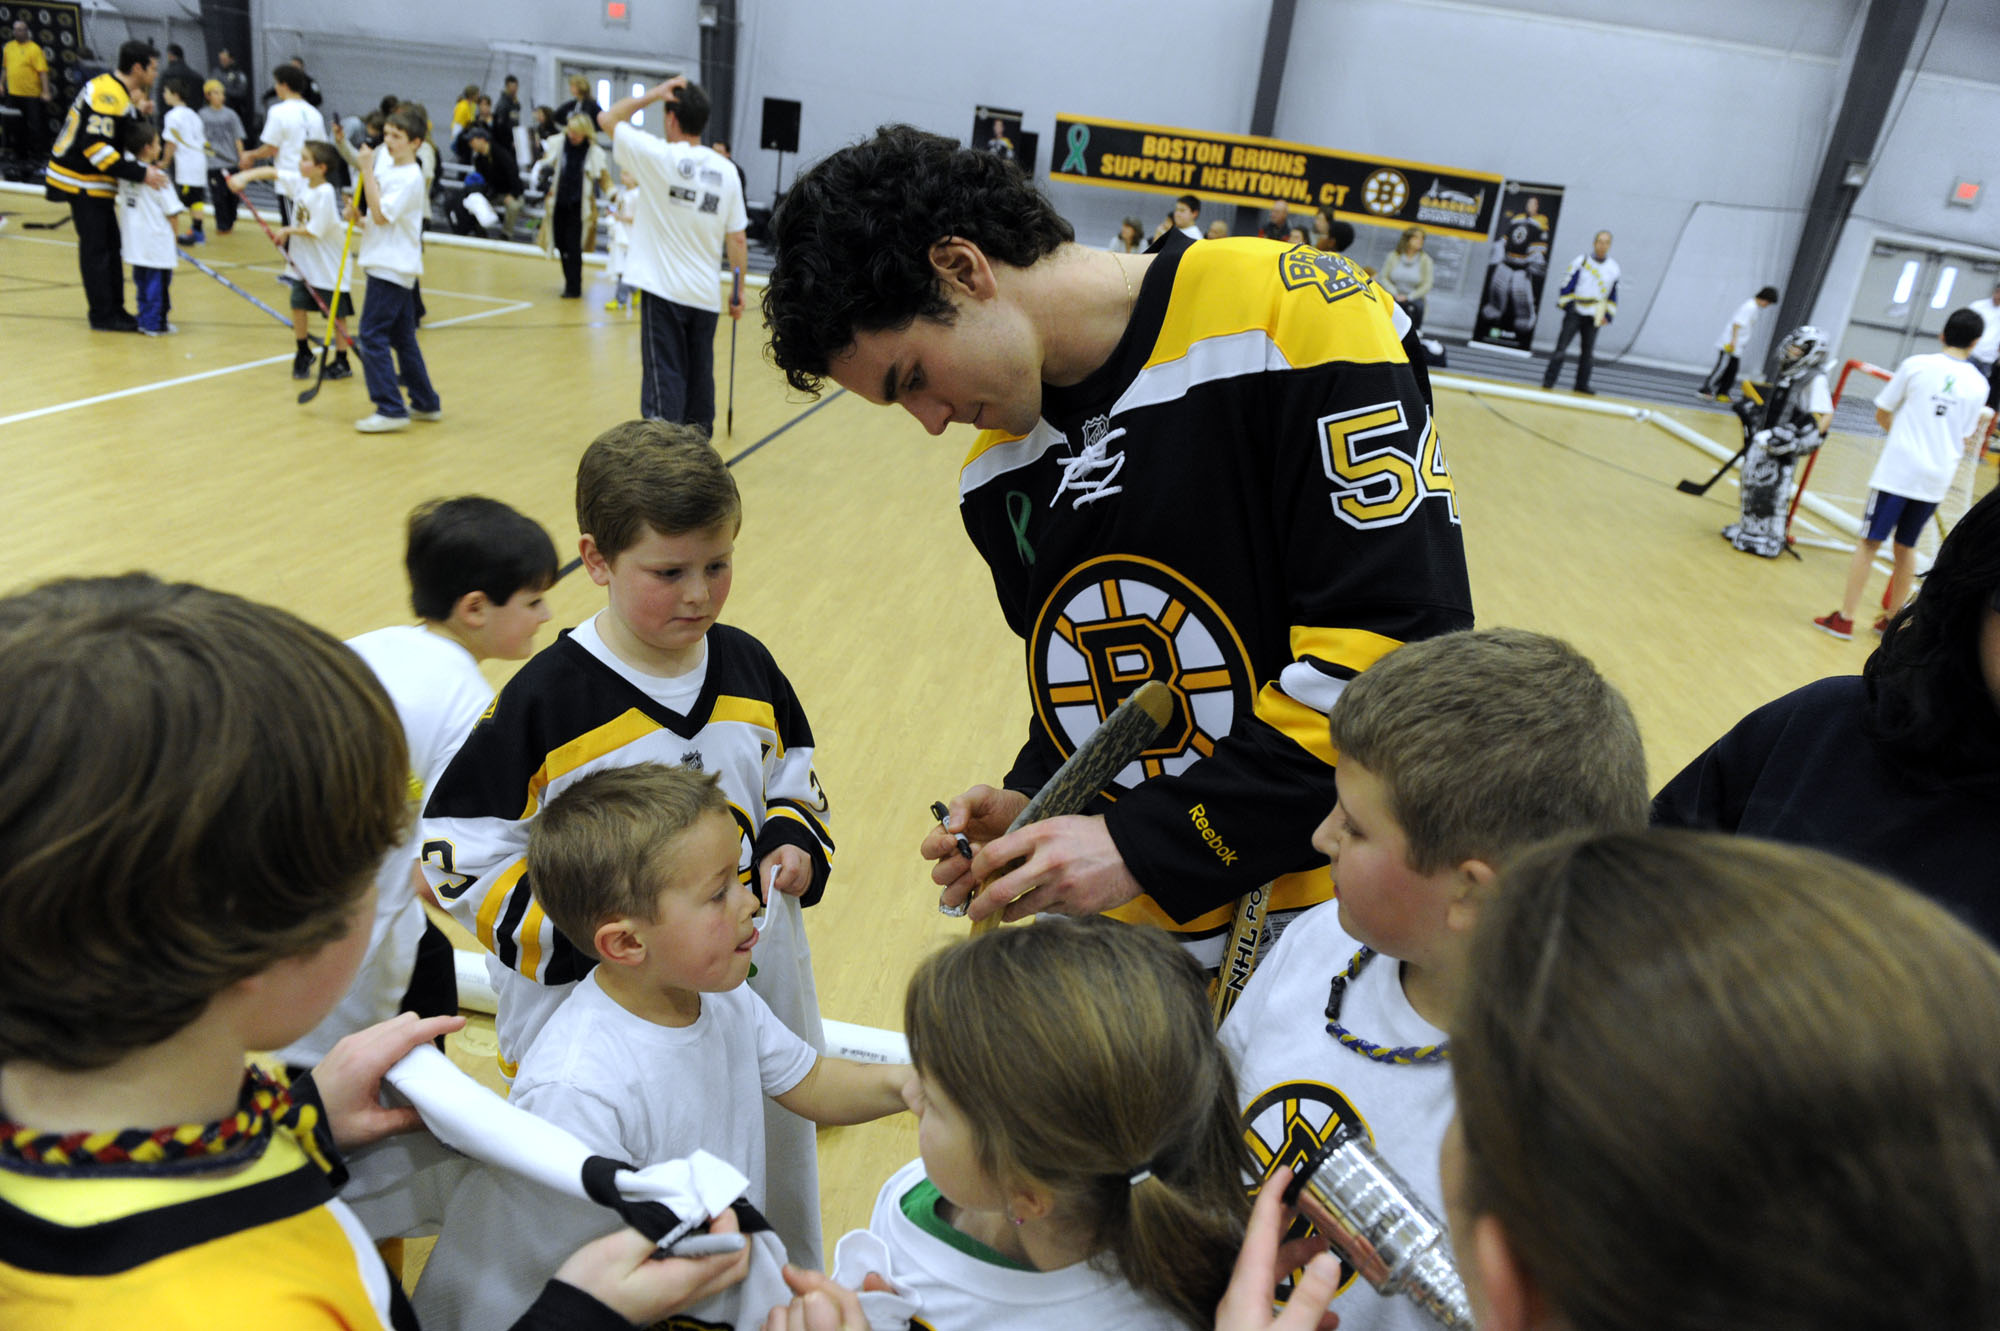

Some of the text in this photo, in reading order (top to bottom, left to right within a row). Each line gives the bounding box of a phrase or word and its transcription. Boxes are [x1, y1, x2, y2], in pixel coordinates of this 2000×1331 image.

[1100, 152, 1350, 207] SUPPORT NEWTOWN, CT
[1141, 134, 1308, 177] BOSTON BRUINS
[1317, 400, 1461, 530] 54
[1188, 803, 1238, 866] Reebok
[1227, 928, 1258, 992] NHL
